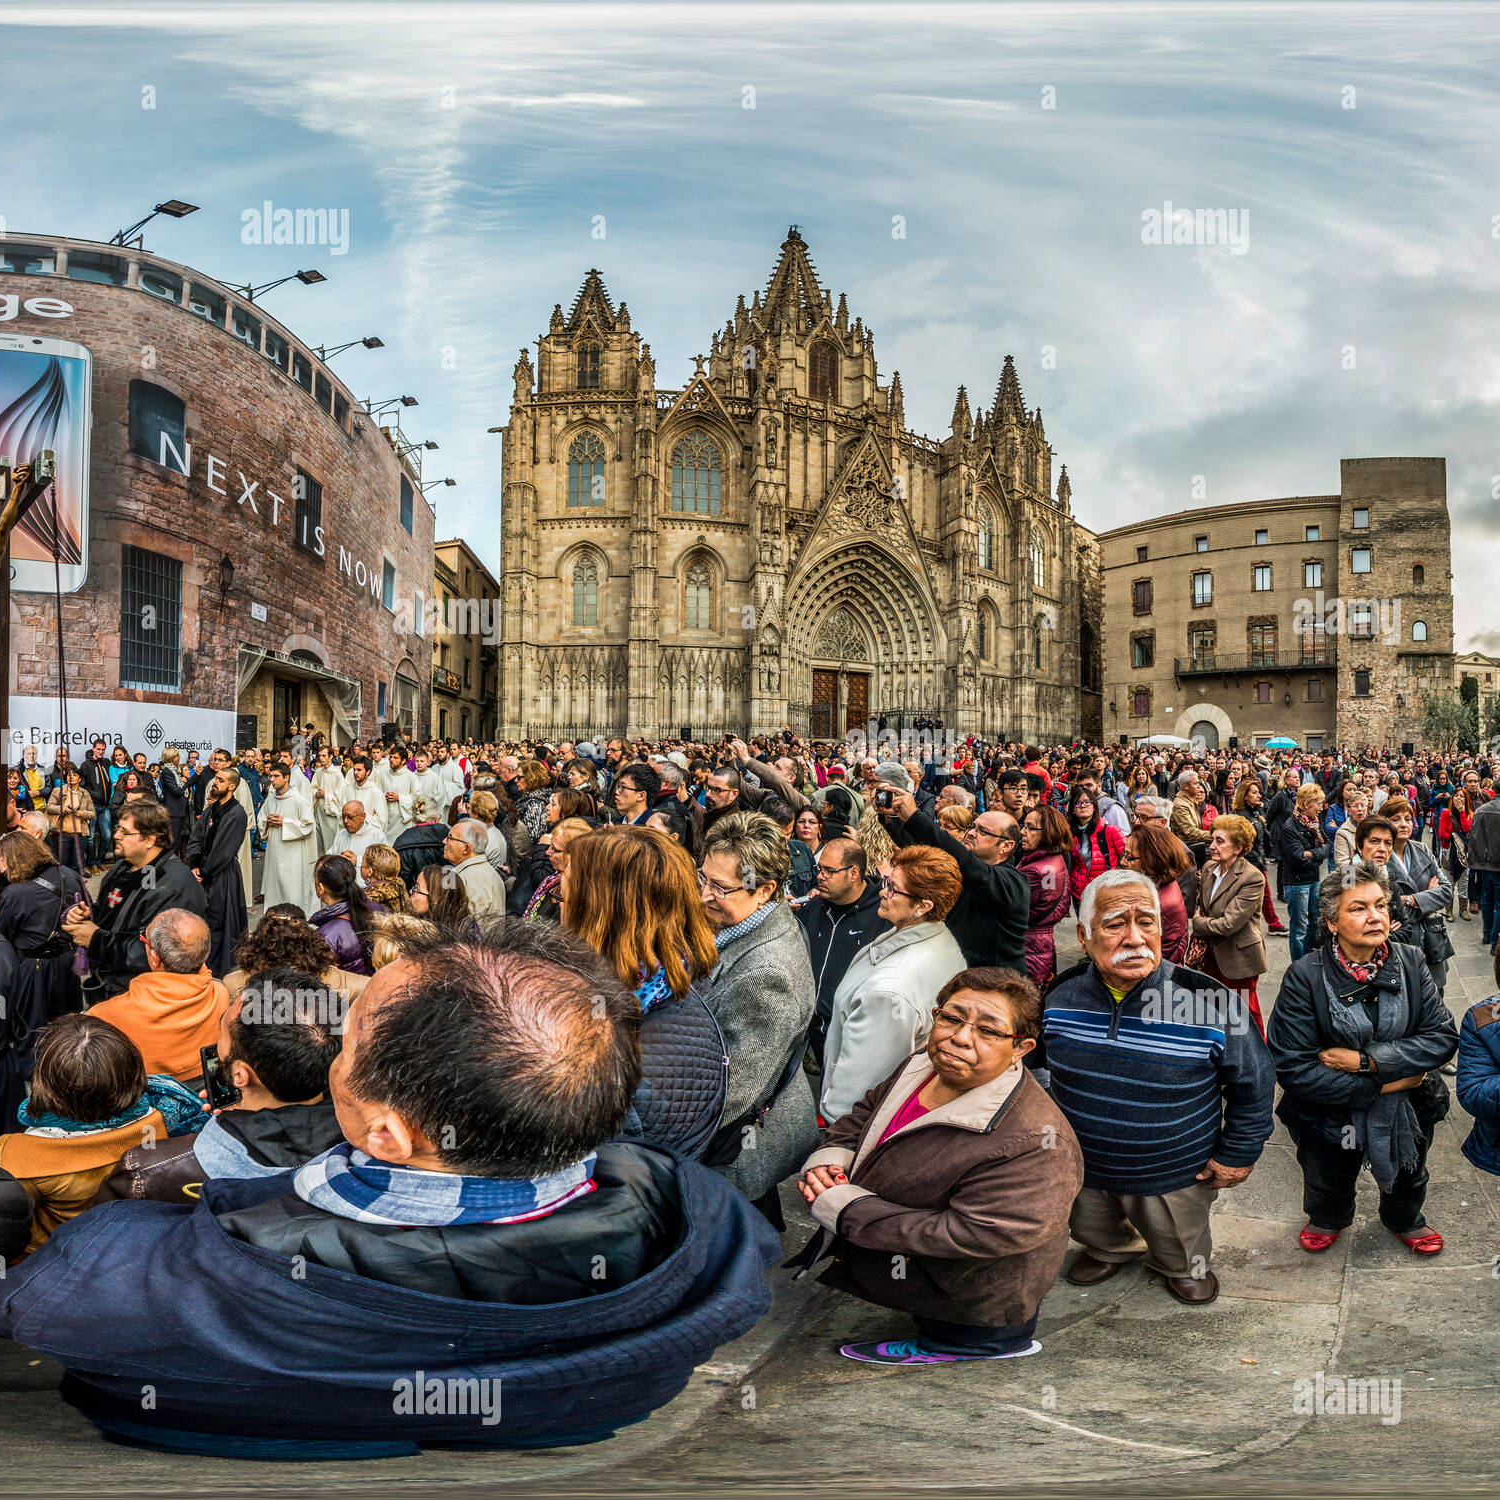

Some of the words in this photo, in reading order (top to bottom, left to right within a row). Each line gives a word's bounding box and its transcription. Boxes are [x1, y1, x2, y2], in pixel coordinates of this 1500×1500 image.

[159, 430, 285, 525] NEXT
[303, 515, 326, 556] IS
[339, 544, 384, 599] NOW
[30, 726, 123, 746] Barcelona
